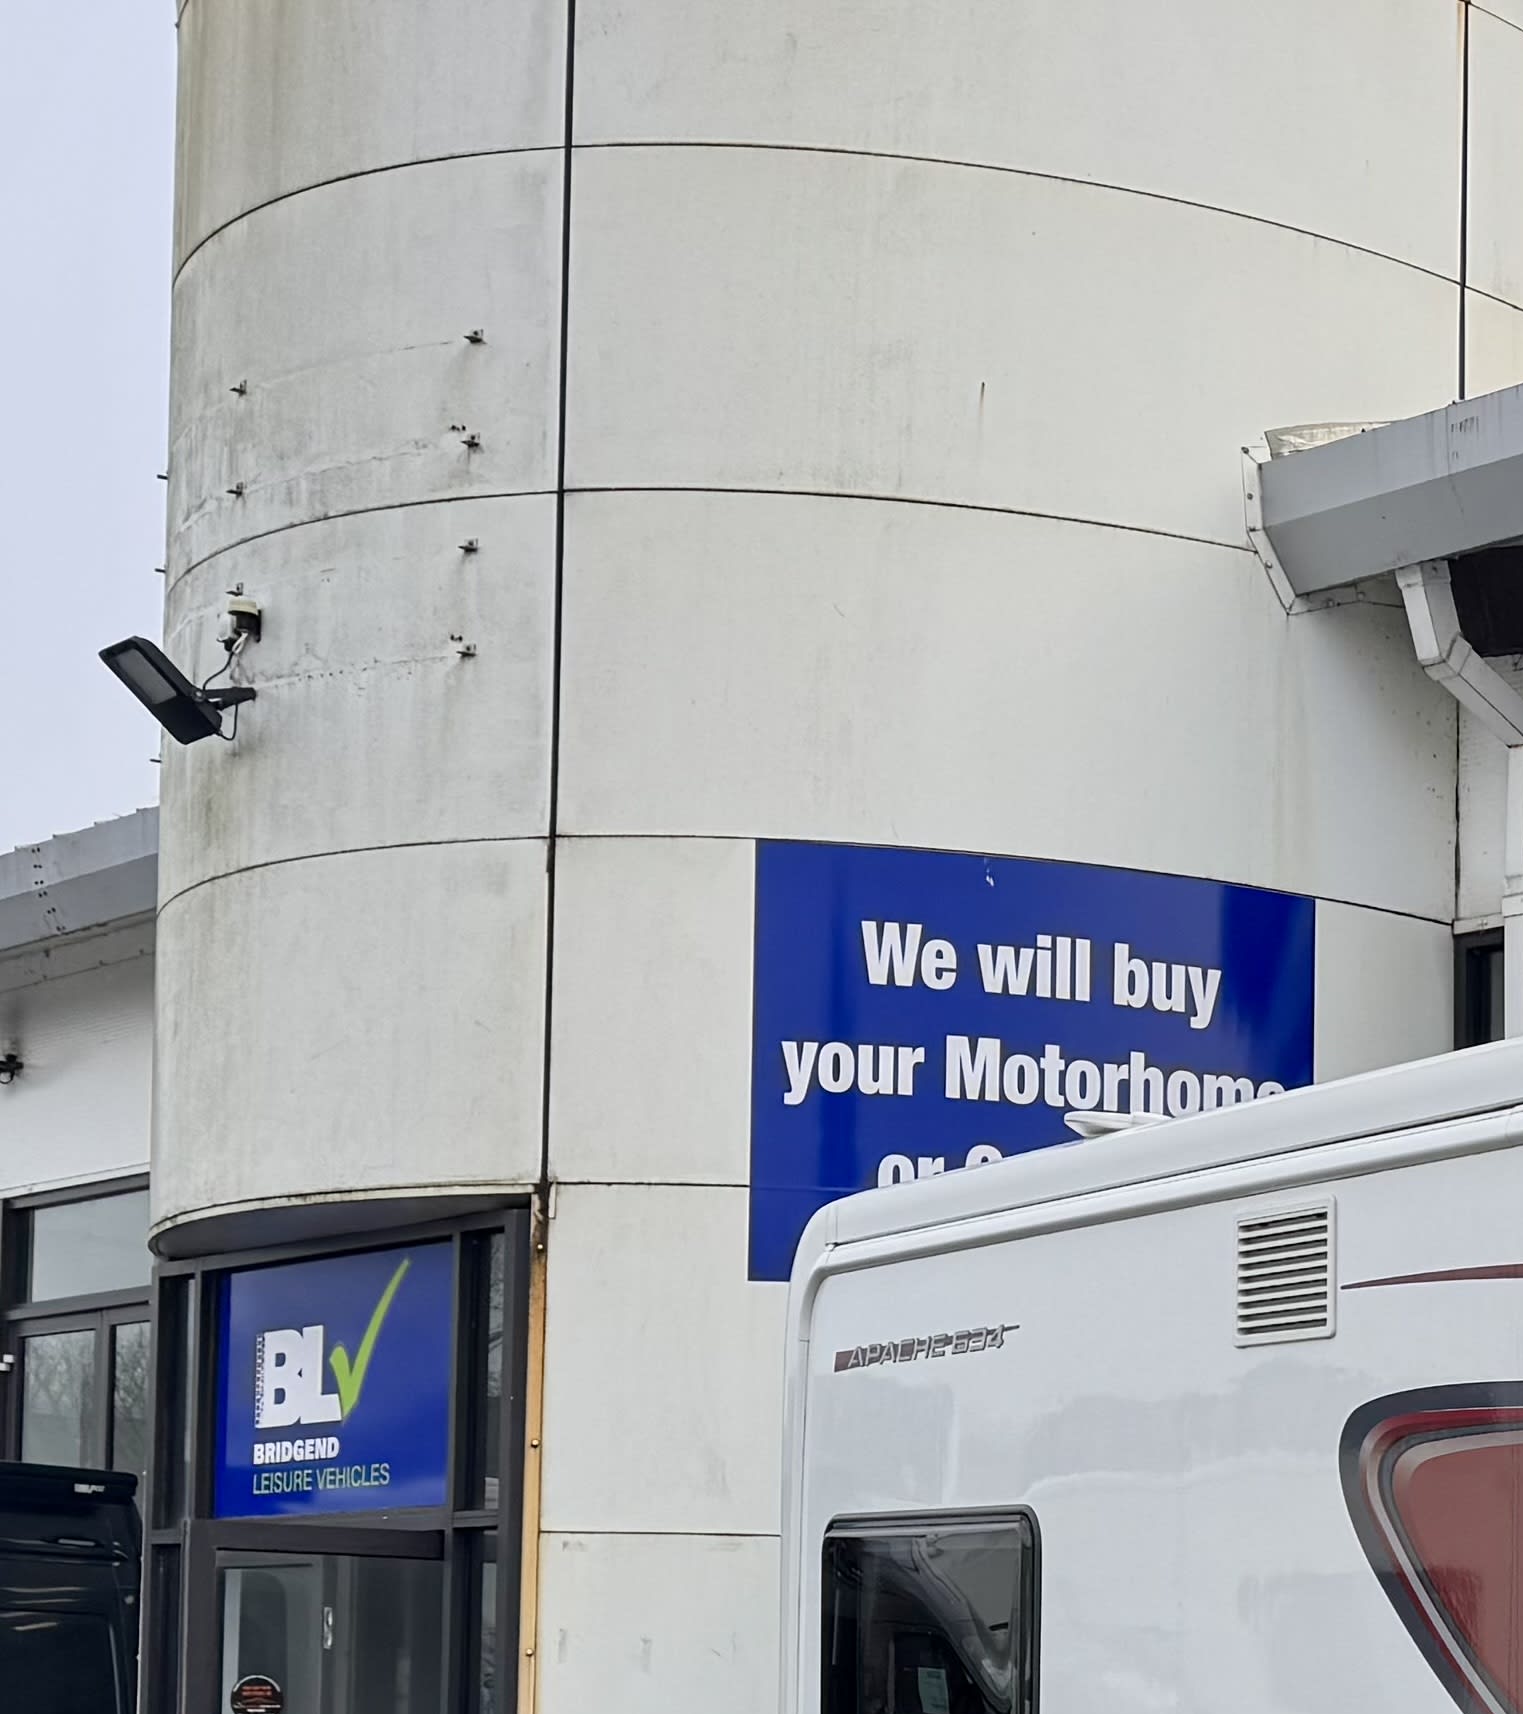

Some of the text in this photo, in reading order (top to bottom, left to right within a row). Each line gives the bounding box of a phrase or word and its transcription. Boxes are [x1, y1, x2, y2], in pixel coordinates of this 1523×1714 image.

[861, 919, 1221, 1029] We will buy
[781, 1039, 925, 1105] your
[847, 1325, 1007, 1367] APACHE 634
[256, 1325, 342, 1428] BL
[253, 1437, 340, 1465] BRIDGEND
[253, 1463, 390, 1495] LEISURE VEHICLES
